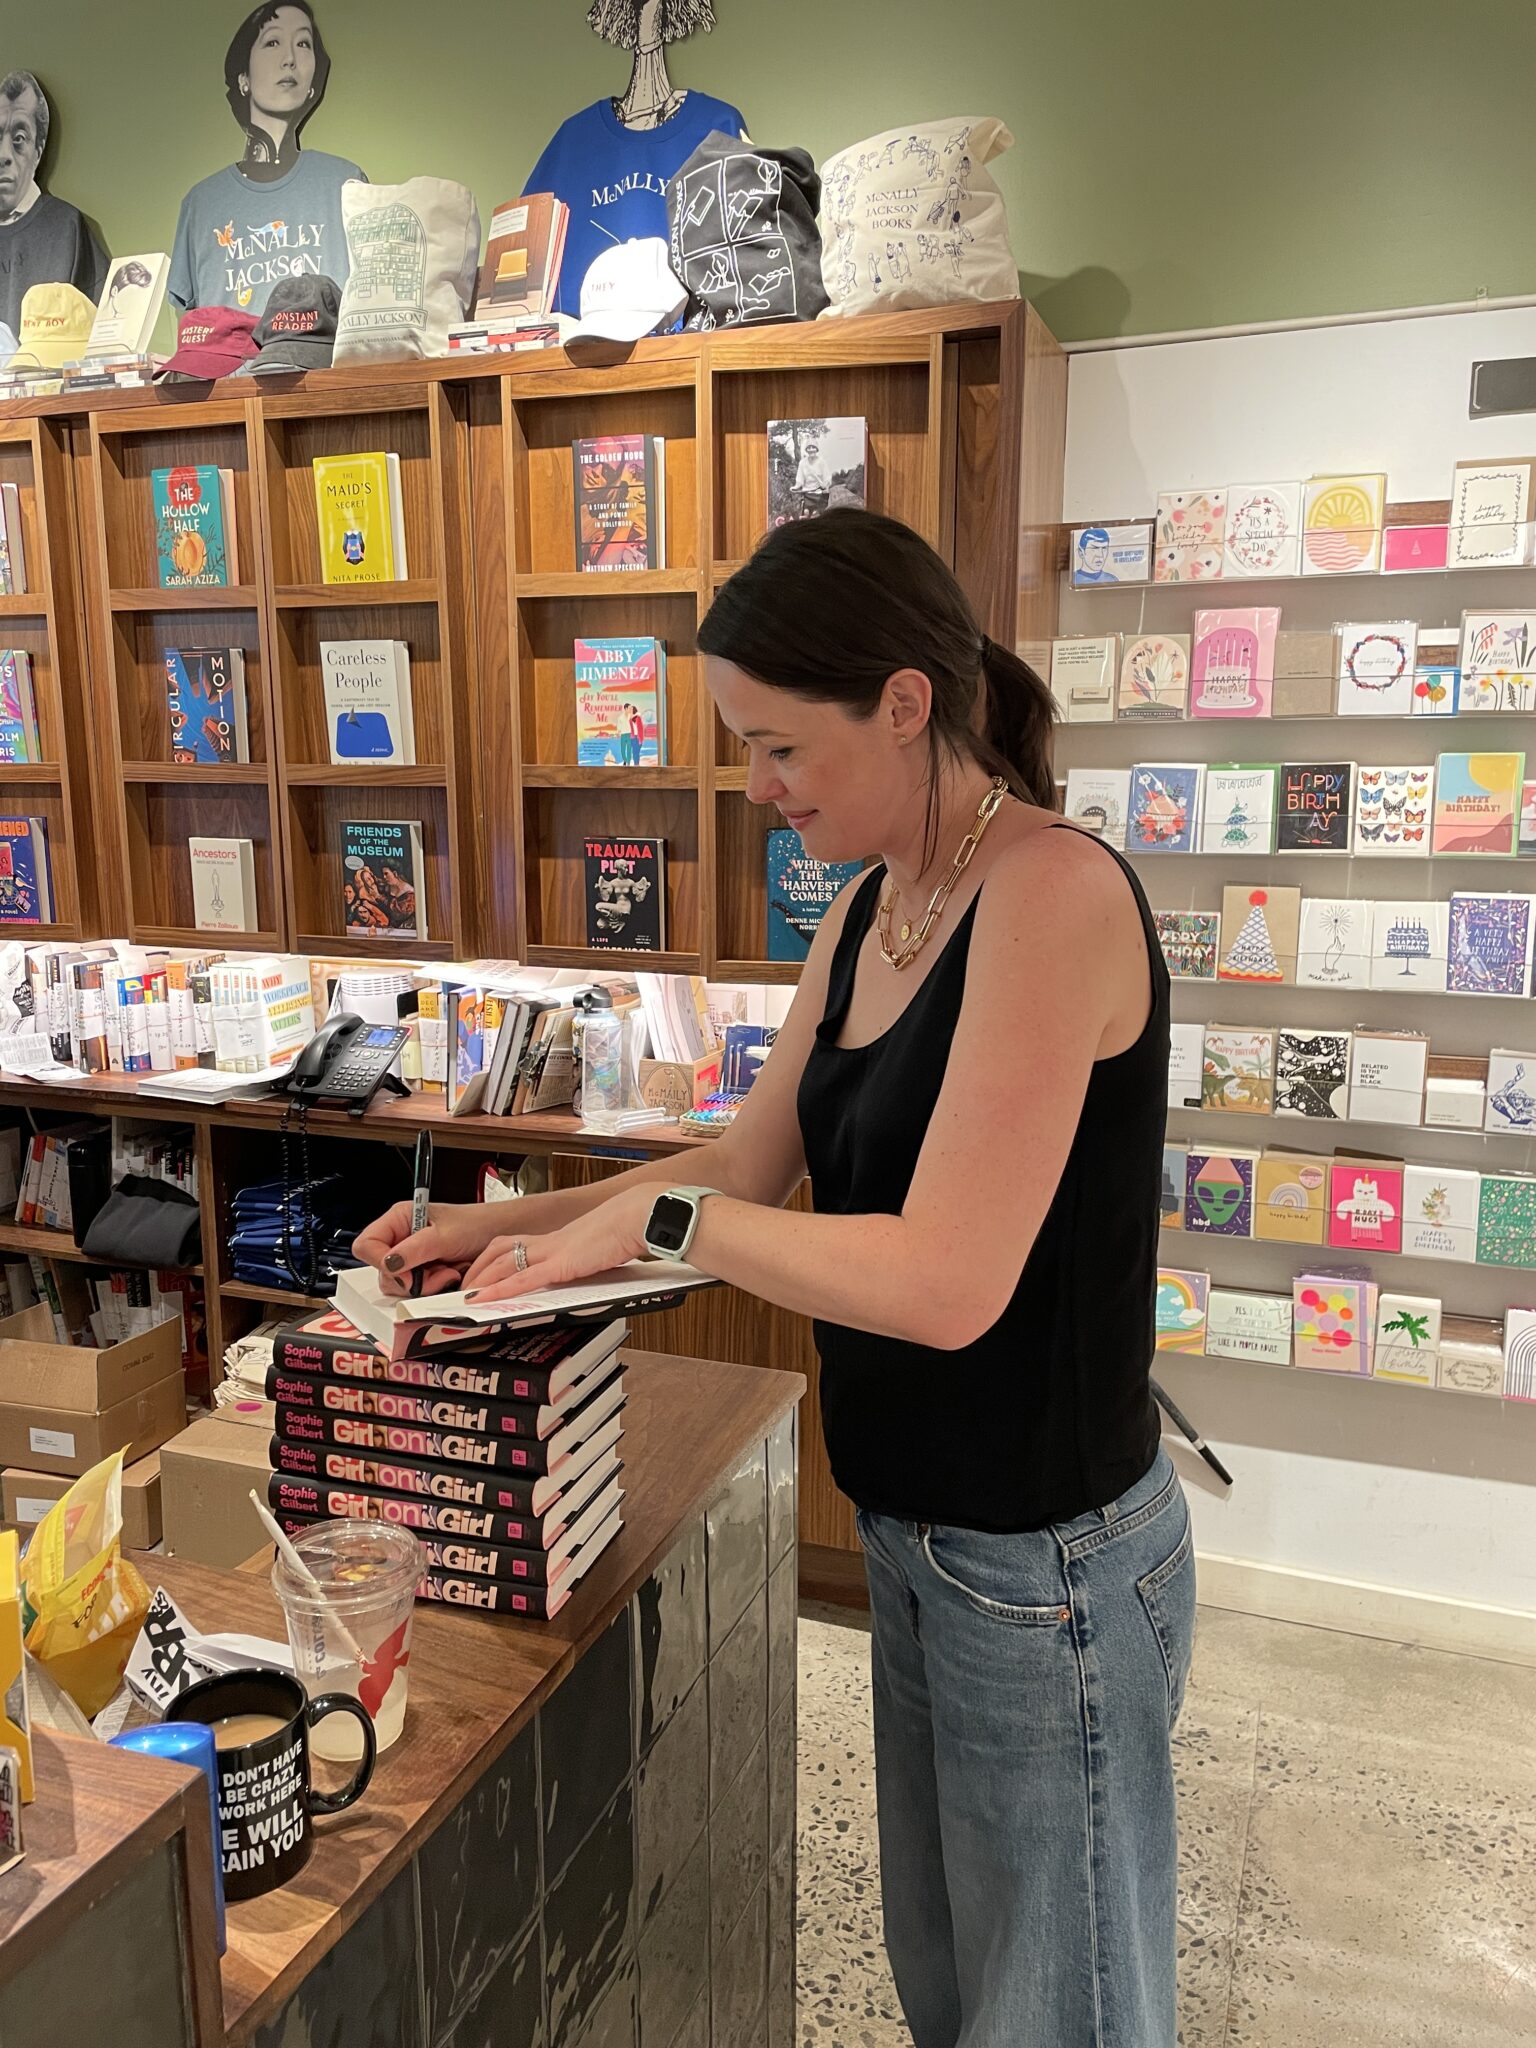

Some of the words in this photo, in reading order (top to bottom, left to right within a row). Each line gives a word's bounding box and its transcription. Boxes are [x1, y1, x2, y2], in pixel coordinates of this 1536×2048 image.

[591, 172, 670, 207] McNALLY
[865, 187, 919, 204] McNALLY
[865, 204, 919, 218] JACKSON
[872, 219, 912, 230] BOOKS
[224, 224, 325, 262] McNALLY
[225, 253, 322, 291] JACKSON
[271, 310, 319, 322] CONSTANT
[374, 312, 422, 326] JACKSON
[272, 321, 314, 331] READER
[181, 334, 206, 344] GUEST
[580, 454, 593, 464] THE
[595, 452, 622, 464] GOLDEN
[624, 451, 645, 462] HOUR
[174, 487, 194, 501] THE
[327, 482, 372, 497] MAID'S
[162, 502, 210, 518] HOLLOW
[335, 500, 365, 510] SECRET
[1476, 504, 1503, 513] happy
[610, 511, 628, 519] POWER
[1471, 510, 1507, 521] birthday
[174, 519, 200, 532] HALF
[1171, 533, 1207, 542] birthday
[1244, 530, 1273, 542] SPECIAL
[1252, 542, 1268, 552] DAY
[165, 574, 192, 586] SARAH
[195, 574, 221, 585] AZIZA
[332, 574, 351, 583] NITA
[354, 572, 381, 581] PROSE
[327, 648, 387, 666] Careless
[594, 650, 635, 663] ABBY
[581, 666, 650, 681] JIMENEZ
[1212, 675, 1242, 684] HAPPY
[335, 672, 382, 693] People
[1206, 684, 1248, 694] BIRTHDAY
[166, 658, 186, 763] CIRCULAR
[211, 656, 231, 751] MOTION
[1287, 793, 1340, 810] BIRTH
[1456, 795, 1491, 804] HAPPY
[1446, 804, 1500, 812] BIRTHDAY!
[346, 826, 402, 837] FRIENDS
[193, 848, 237, 859] Ancestors
[347, 845, 403, 857] MUSEUM
[586, 843, 652, 858] TRAUMA
[601, 860, 635, 874] PLT
[794, 860, 830, 870] WHEN
[799, 871, 824, 880] THE
[783, 881, 840, 891] HARVEST
[790, 891, 833, 901] COMES
[1160, 931, 1201, 942] APPY
[1474, 929, 1480, 937] A
[1484, 929, 1503, 938] VERY
[1475, 938, 1502, 947] HAPPY
[1163, 946, 1212, 958] THDAY
[262, 973, 283, 990] WHY
[264, 980, 309, 1004] WORKPLACE
[1216, 1046, 1234, 1055] HAPPY
[1192, 1217, 1210, 1226] hbd
[1218, 1338, 1230, 1347] LIKE
[284, 1343, 323, 1359] Sophie
[284, 1358, 324, 1372] Gilbert
[332, 1351, 374, 1378] Girl
[389, 1361, 426, 1386] on
[442, 1366, 500, 1395] Girl
[275, 1378, 313, 1394] Sophie
[276, 1392, 314, 1405] Gilbert
[323, 1386, 364, 1413] Girl
[379, 1397, 415, 1420] on
[431, 1402, 487, 1431] Girl
[286, 1411, 323, 1427] Sophie
[286, 1425, 324, 1439] Gilbert
[334, 1419, 374, 1447] Girl
[389, 1429, 425, 1453] on
[442, 1435, 498, 1465] Girl
[280, 1445, 316, 1461] Sophie
[281, 1459, 317, 1473] Gilbert
[326, 1454, 365, 1482] Girl
[379, 1467, 415, 1491] on
[431, 1474, 485, 1505] Girl
[280, 1484, 318, 1499] Sophie
[280, 1497, 319, 1512] Gilbert
[328, 1492, 368, 1518] Girl
[384, 1503, 422, 1527] on
[437, 1507, 494, 1538] Girl
[442, 1545, 498, 1576] Girl
[442, 1579, 498, 1609] Girl
[223, 1761, 269, 1788] DON'T
[273, 1738, 302, 1772] HAVE
[226, 1785, 248, 1804] BE
[252, 1762, 296, 1798] CRAZY
[219, 1799, 267, 1821] WORK
[270, 1773, 302, 1807] HERE
[247, 1799, 303, 1845] WILL
[270, 1818, 304, 1859] YOU
